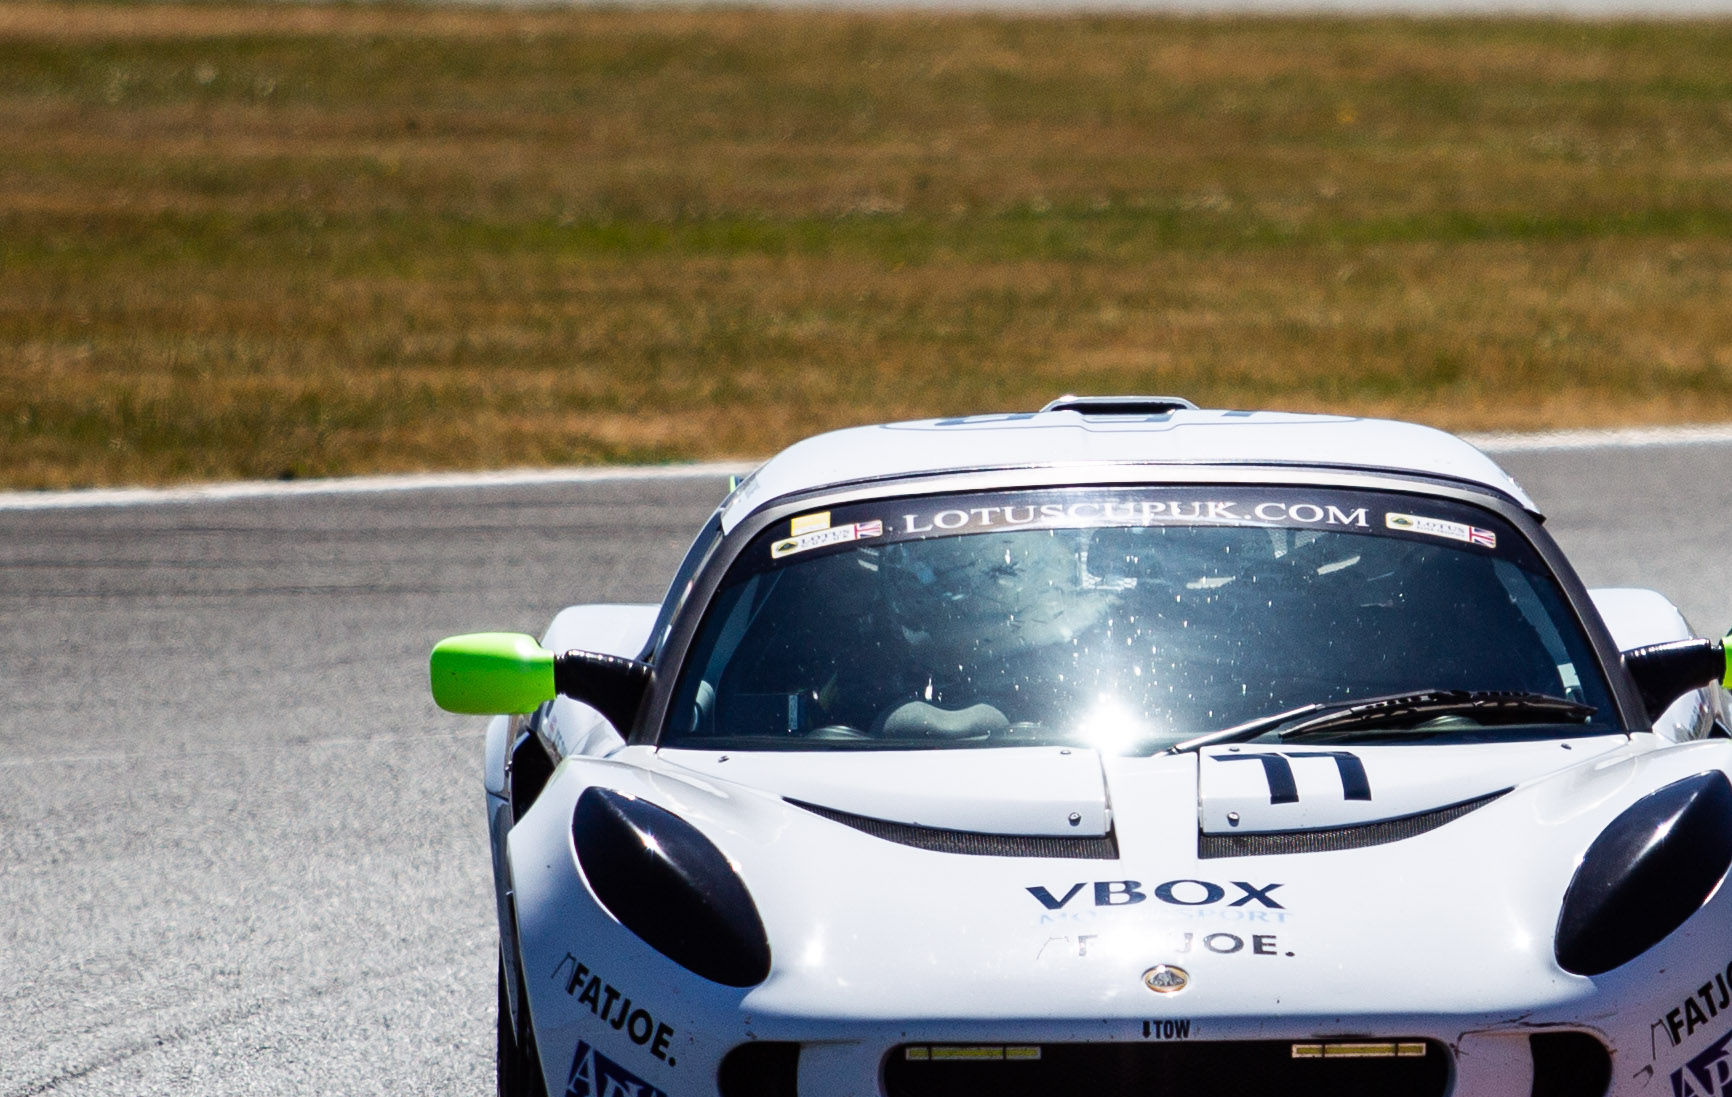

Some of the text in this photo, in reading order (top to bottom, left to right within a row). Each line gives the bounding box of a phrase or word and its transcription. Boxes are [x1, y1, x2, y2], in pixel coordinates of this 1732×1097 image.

[903, 501, 1370, 534] LOTUSCUPUK.COM
[1025, 879, 1286, 911] VBOX
[1077, 932, 1296, 957] FJOE.
[567, 962, 677, 1068] FATJOE.
[1153, 1018, 1191, 1040] TOW
